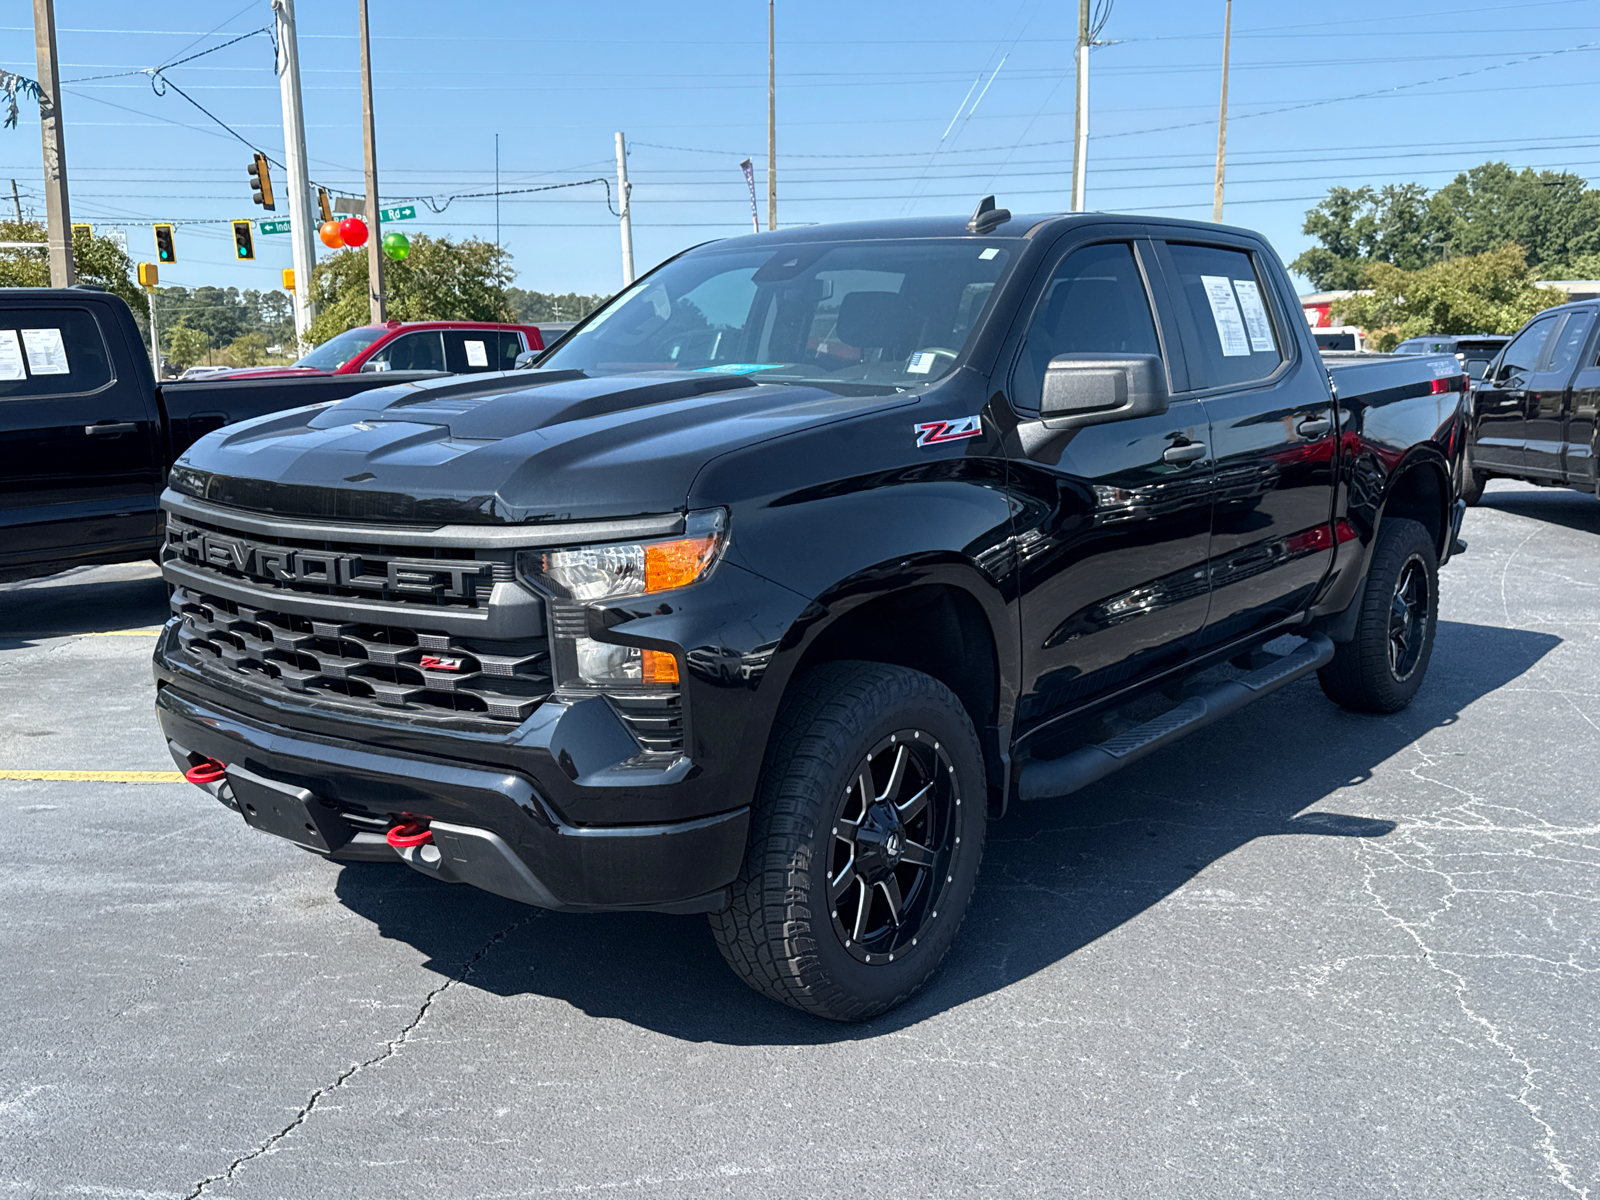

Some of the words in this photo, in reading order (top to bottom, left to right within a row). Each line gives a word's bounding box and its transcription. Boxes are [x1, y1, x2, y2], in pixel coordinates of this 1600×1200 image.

[388, 209, 401, 220] Rd
[275, 221, 291, 232] Indu
[914, 415, 982, 447] Z71
[166, 524, 493, 597] CHEVROLET
